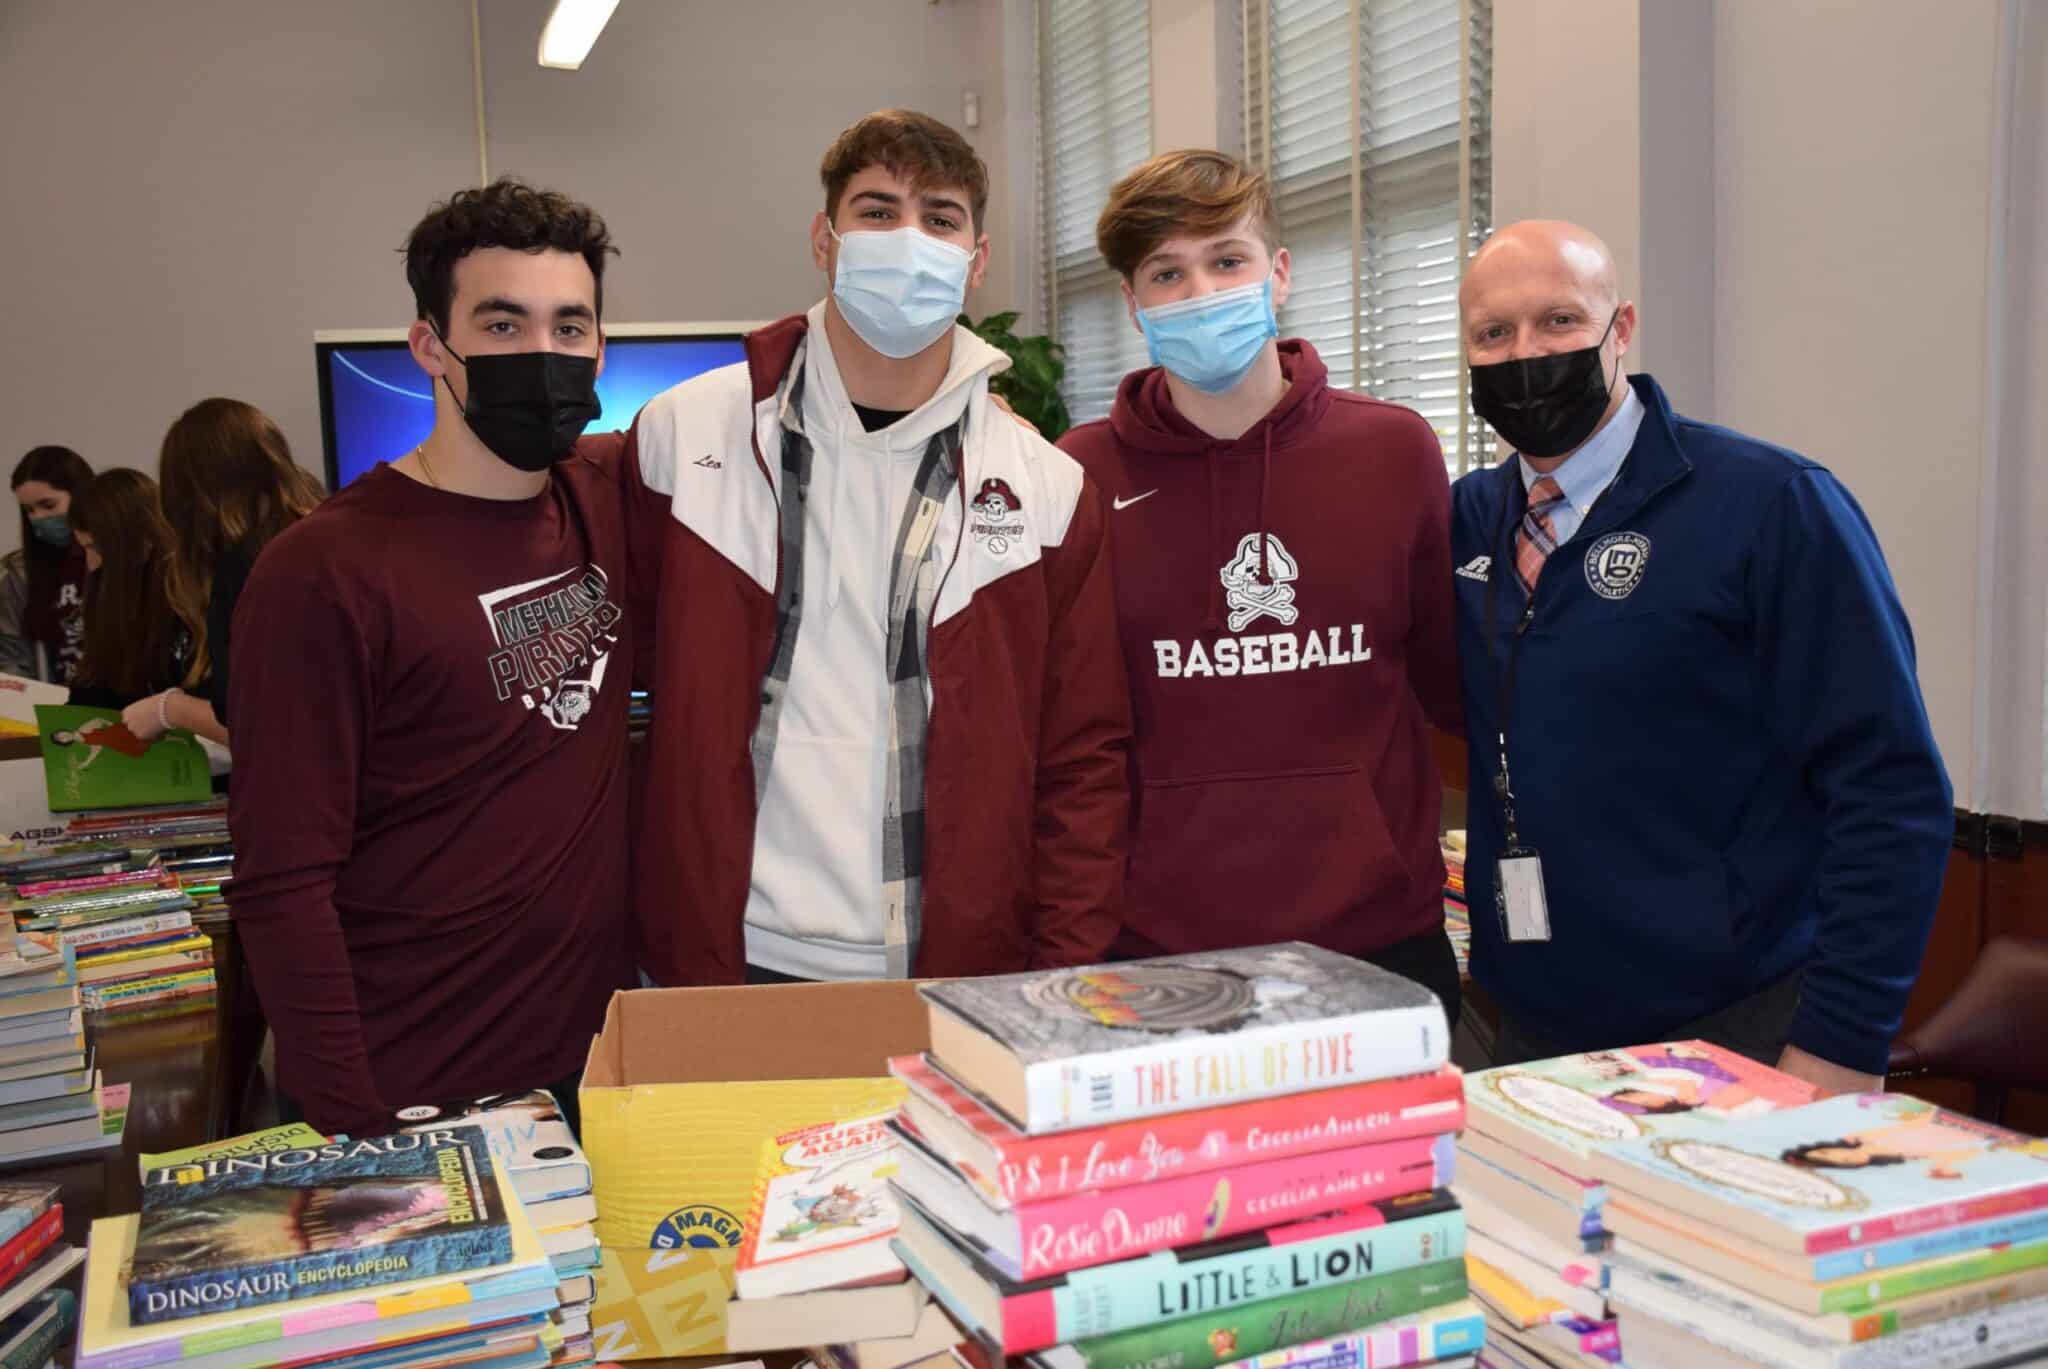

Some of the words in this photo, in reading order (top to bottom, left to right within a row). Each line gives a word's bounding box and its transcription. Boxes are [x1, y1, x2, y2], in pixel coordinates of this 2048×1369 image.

[494, 573, 608, 646] MEPHAM
[1152, 624, 1372, 678] BASEBALL
[1134, 1058, 1180, 1107] THE
[1193, 1050, 1248, 1097] FALL
[1263, 1041, 1289, 1087] OF
[1303, 1032, 1355, 1080] FIVE
[161, 1131, 466, 1184] DINOSAUR
[436, 1146, 475, 1224] ENCYCLOPEDIA
[1077, 1140, 1134, 1189] Love
[1139, 1130, 1185, 1181] You
[1025, 1219, 1100, 1271] Rosie
[148, 1271, 291, 1313] DINOSAUR
[297, 1255, 409, 1285] ENCYCLOPEDIA
[1158, 1265, 1256, 1316] LITTLE
[1265, 1264, 1281, 1289] &
[1291, 1240, 1374, 1288] LION
